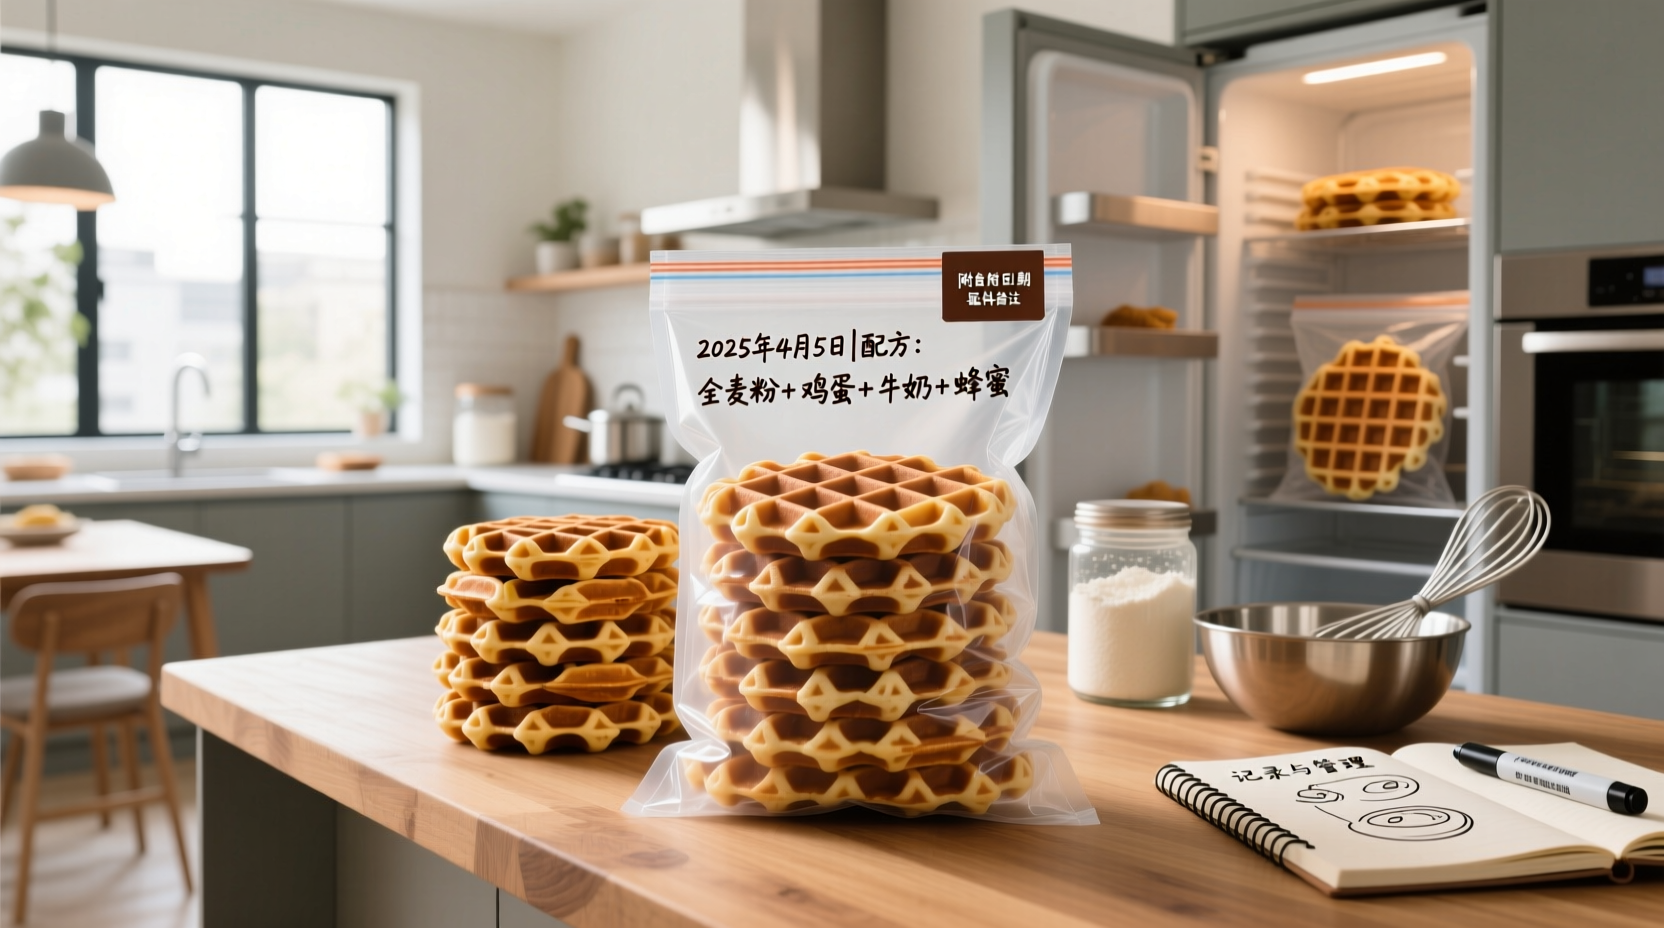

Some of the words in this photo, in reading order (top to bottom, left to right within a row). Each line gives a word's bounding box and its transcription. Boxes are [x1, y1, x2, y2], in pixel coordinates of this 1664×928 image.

[697, 363, 1010, 406] 全麦粉+鸡蛋+牛奶+蜂蜜
[1231, 755, 1375, 782] 记录与管理
